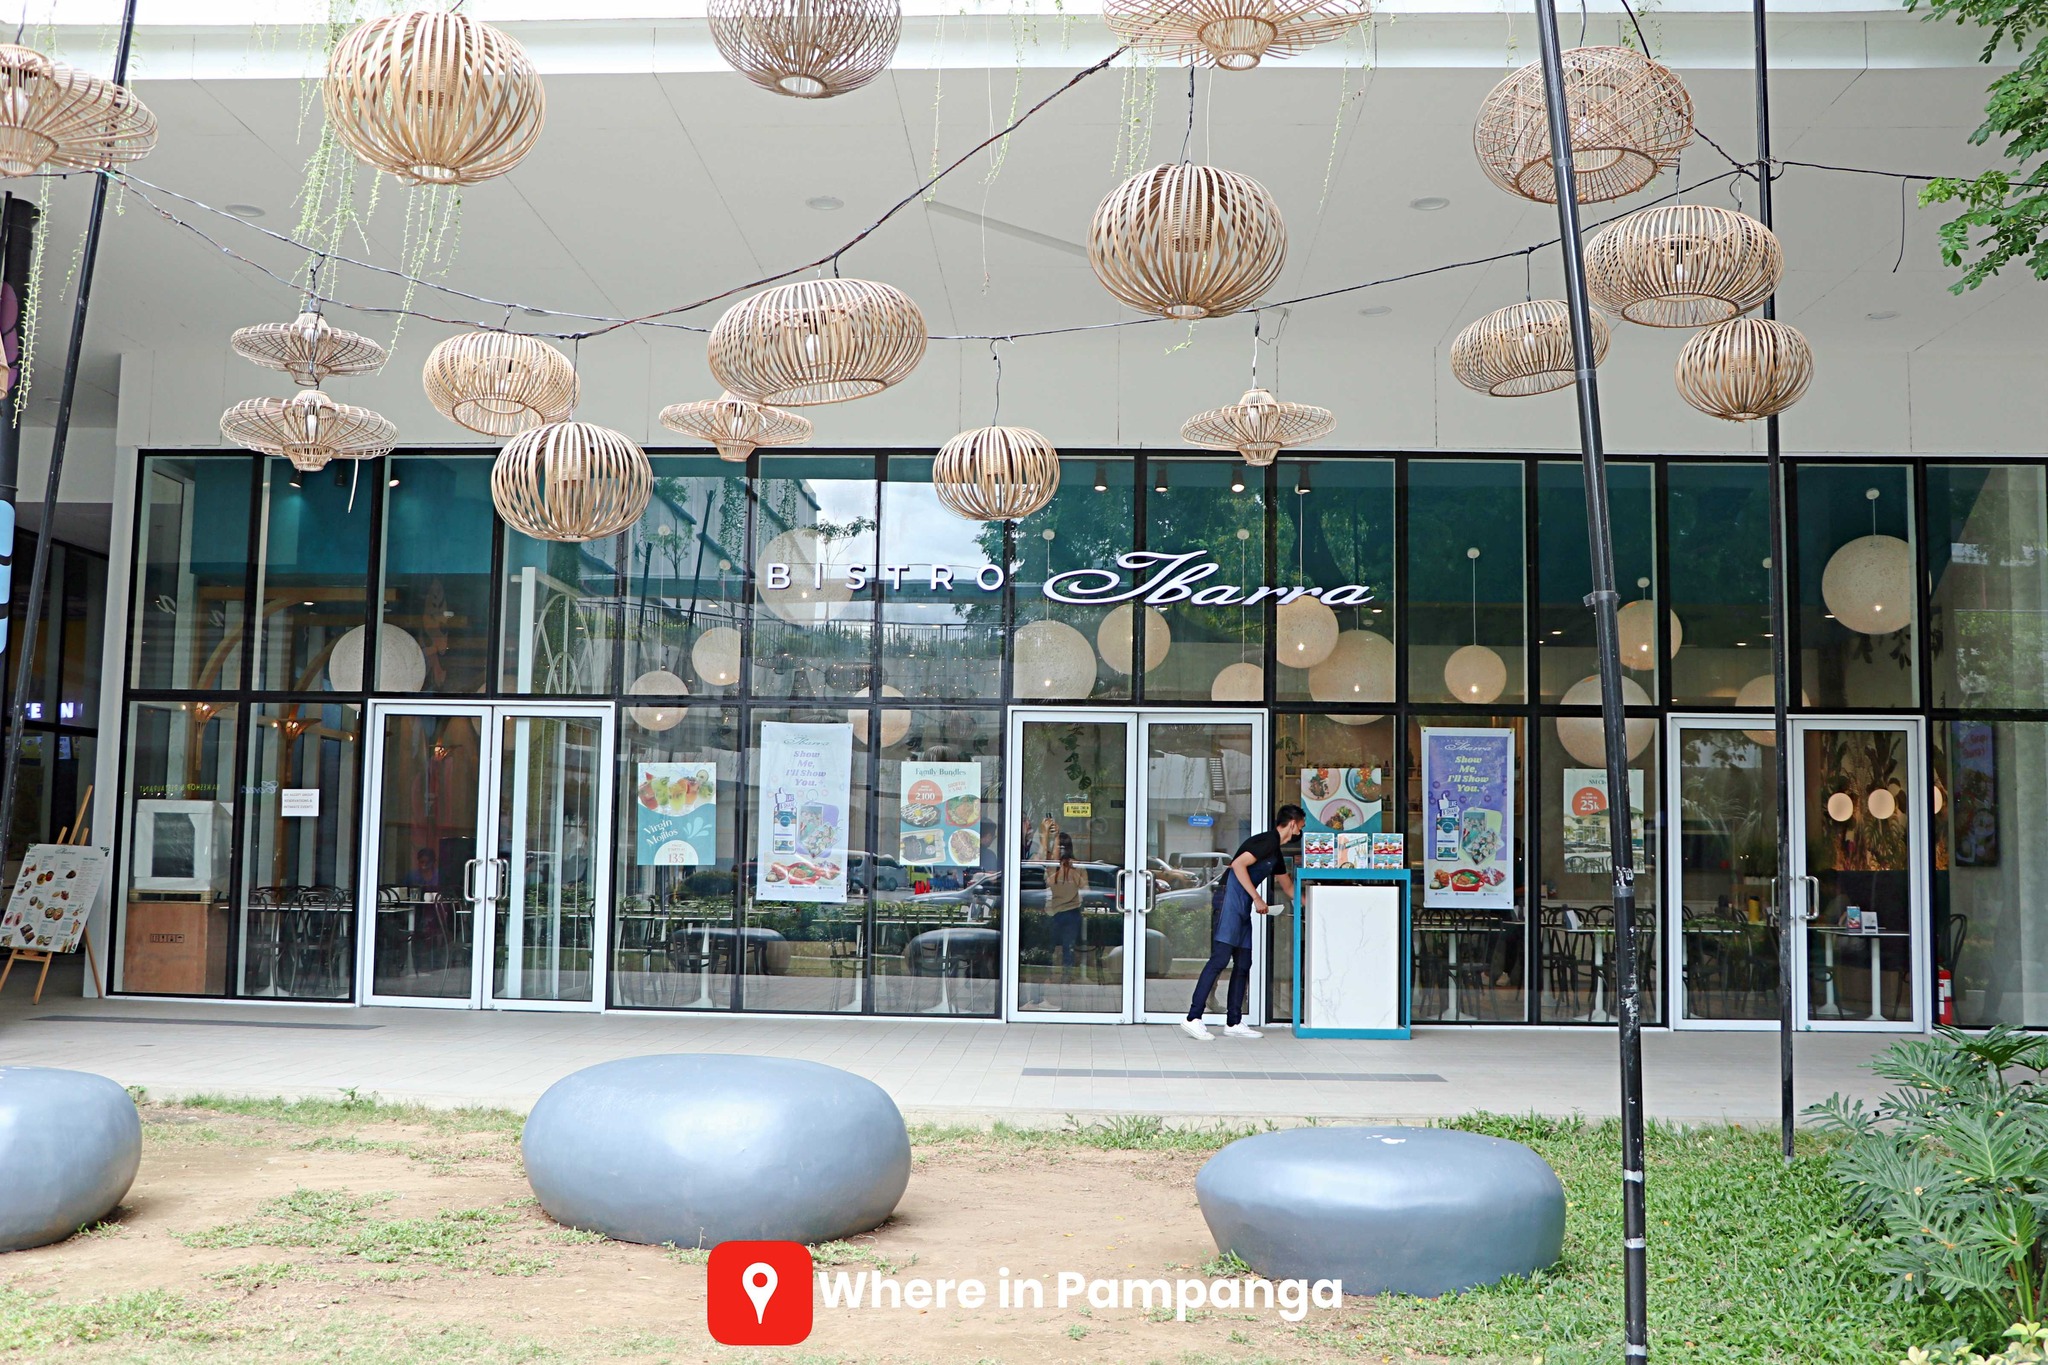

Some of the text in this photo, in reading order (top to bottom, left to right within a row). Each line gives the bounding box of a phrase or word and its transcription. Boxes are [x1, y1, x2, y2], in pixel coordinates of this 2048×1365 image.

[767, 563, 1004, 592] BISTRO
[1042, 549, 1375, 607] Ibarra
[793, 750, 820, 758] Show
[797, 759, 815, 768] Me,
[1454, 755, 1482, 764] Show
[785, 769, 827, 777] I'll Show
[915, 767, 967, 777] Family Bundles
[1458, 764, 1478, 774] Me,
[794, 778, 817, 787] You.
[1447, 774, 1490, 783] I'll Show
[1457, 784, 1480, 793] You.
[1580, 799, 1600, 811] 25k
[643, 819, 673, 835] Virgin
[646, 828, 679, 847] Mojitos
[668, 853, 685, 864] 135
